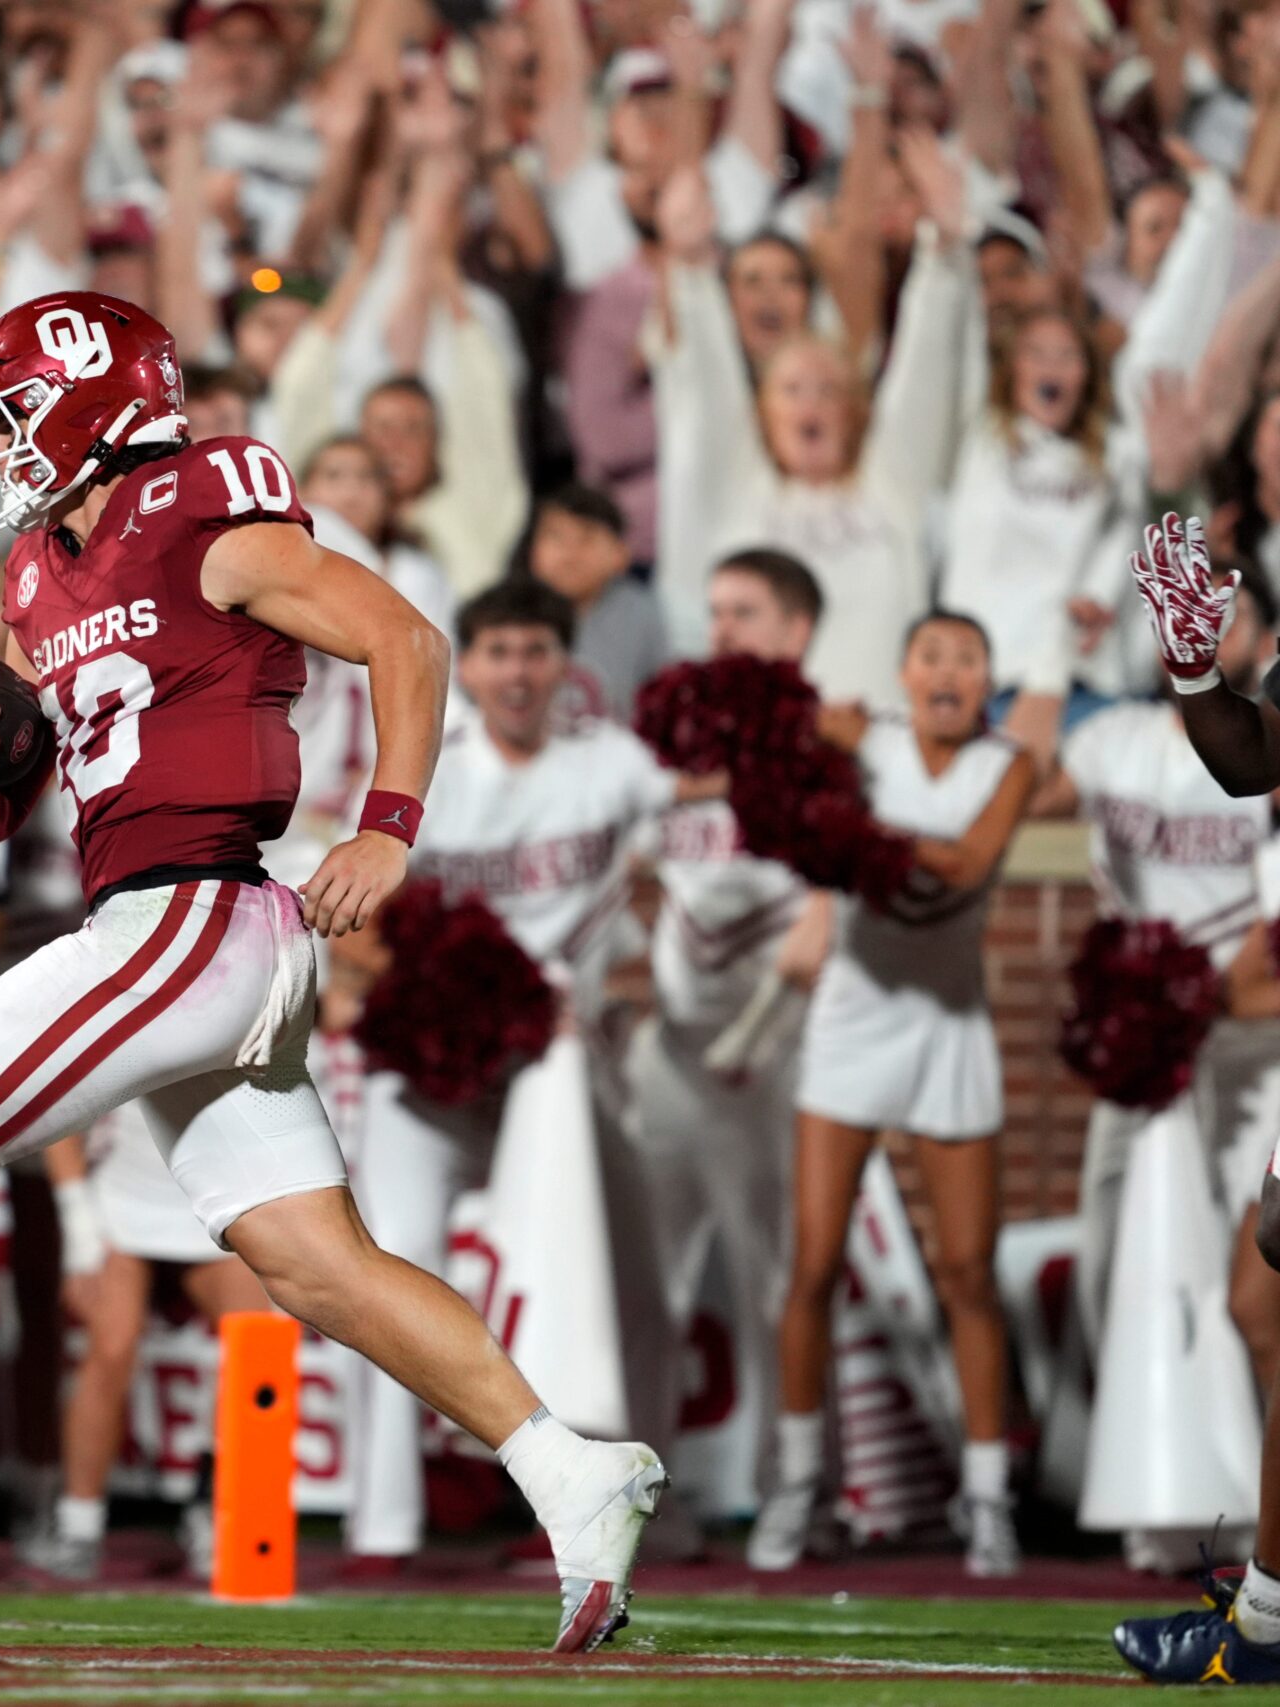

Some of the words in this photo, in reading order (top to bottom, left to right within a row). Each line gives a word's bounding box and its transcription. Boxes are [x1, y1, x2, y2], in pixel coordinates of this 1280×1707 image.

[35, 308, 114, 380] OU
[141, 471, 177, 511] C
[207, 445, 292, 516] 10
[19, 564, 38, 605] SEC
[33, 598, 159, 673] SOONERS
